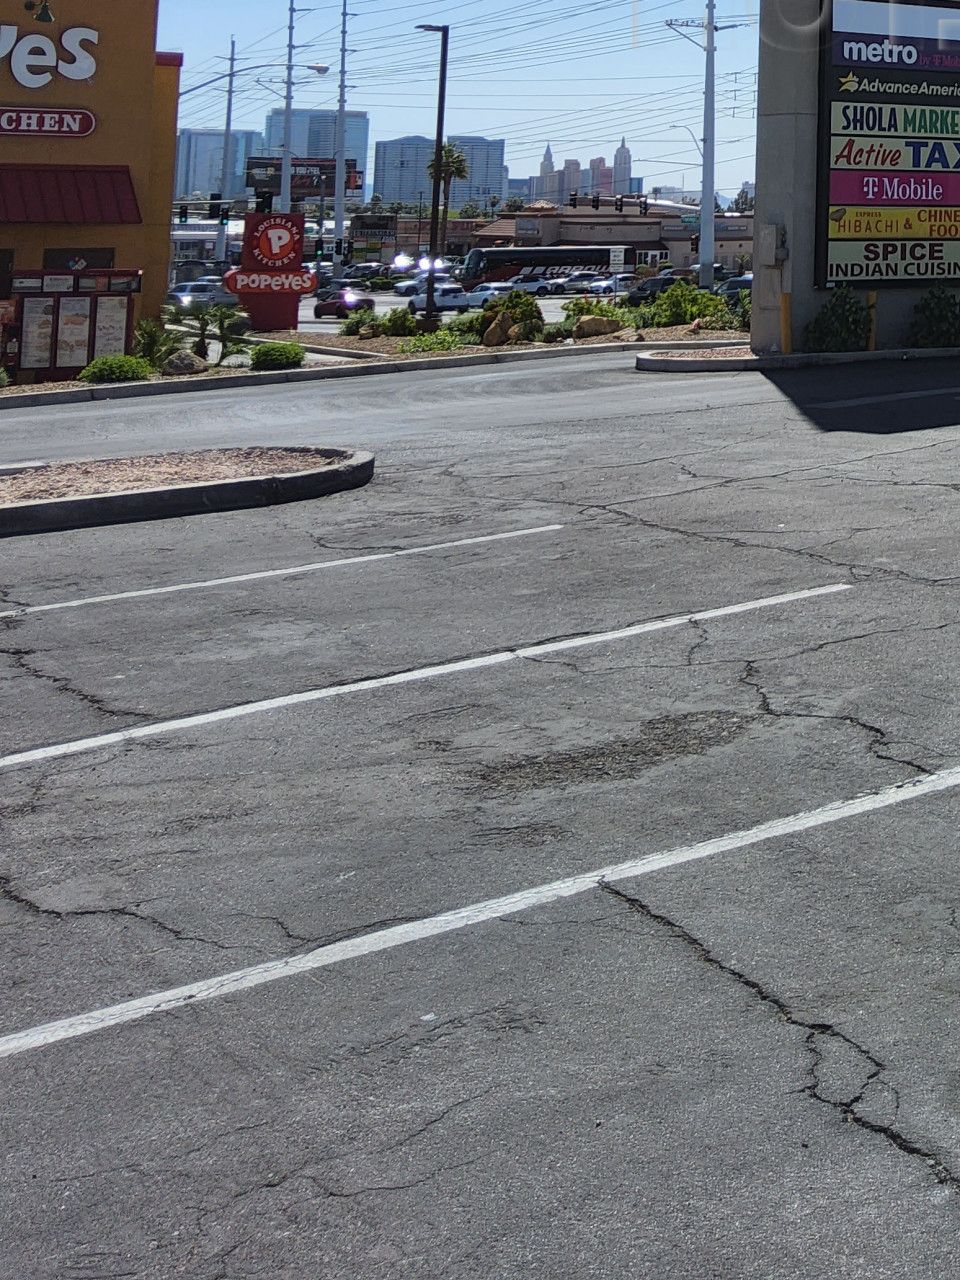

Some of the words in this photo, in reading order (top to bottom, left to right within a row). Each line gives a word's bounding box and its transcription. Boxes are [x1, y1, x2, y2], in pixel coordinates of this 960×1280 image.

[843, 39, 918, 64] metro
[841, 105, 899, 132] SHOLA
[834, 138, 902, 166] Active
[254, 218, 300, 240] LOUISIANA
[837, 220, 899, 233] HIBACHI
[903, 218, 913, 230] &
[253, 247, 296, 267] KITCHEN
[863, 242, 945, 262] SPICE
[829, 262, 899, 277] INDIAN
